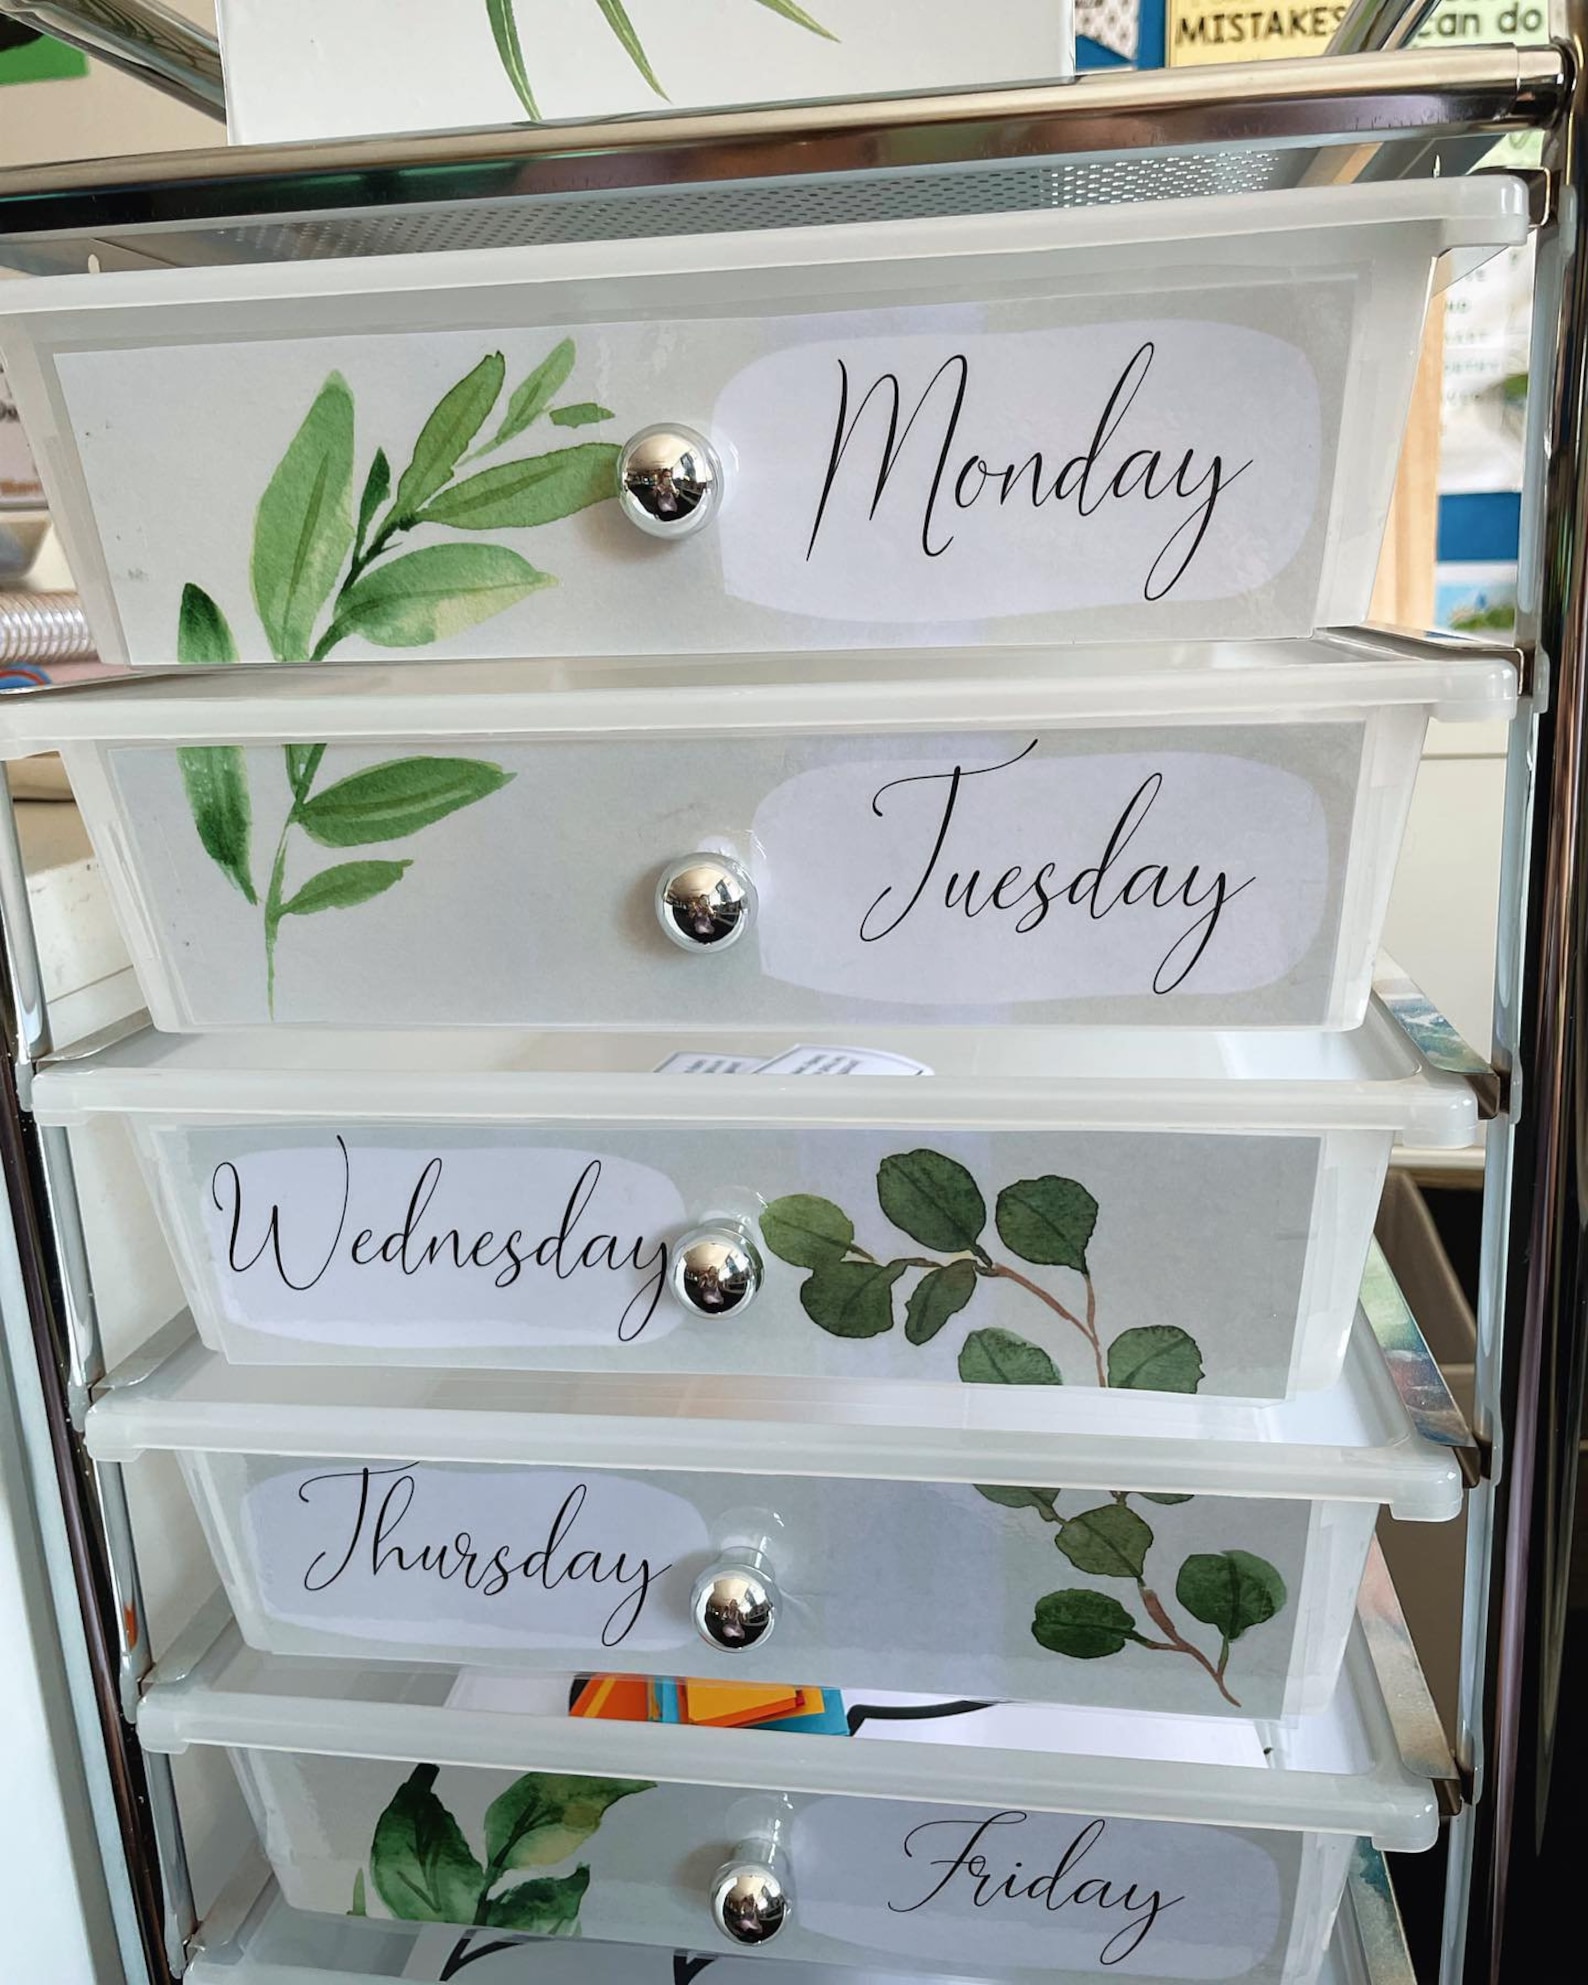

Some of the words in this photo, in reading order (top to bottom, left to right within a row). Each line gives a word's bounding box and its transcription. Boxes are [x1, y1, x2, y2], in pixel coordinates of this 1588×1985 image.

[1174, 5, 1346, 47] MISTAKES
[1497, 1, 1542, 34] do
[806, 341, 1254, 602] Monday
[859, 738, 1257, 995] Tuesday
[212, 1134, 671, 1342] Wednesday
[298, 1461, 673, 1647] Thursday
[887, 1810, 1186, 1966] Friday
